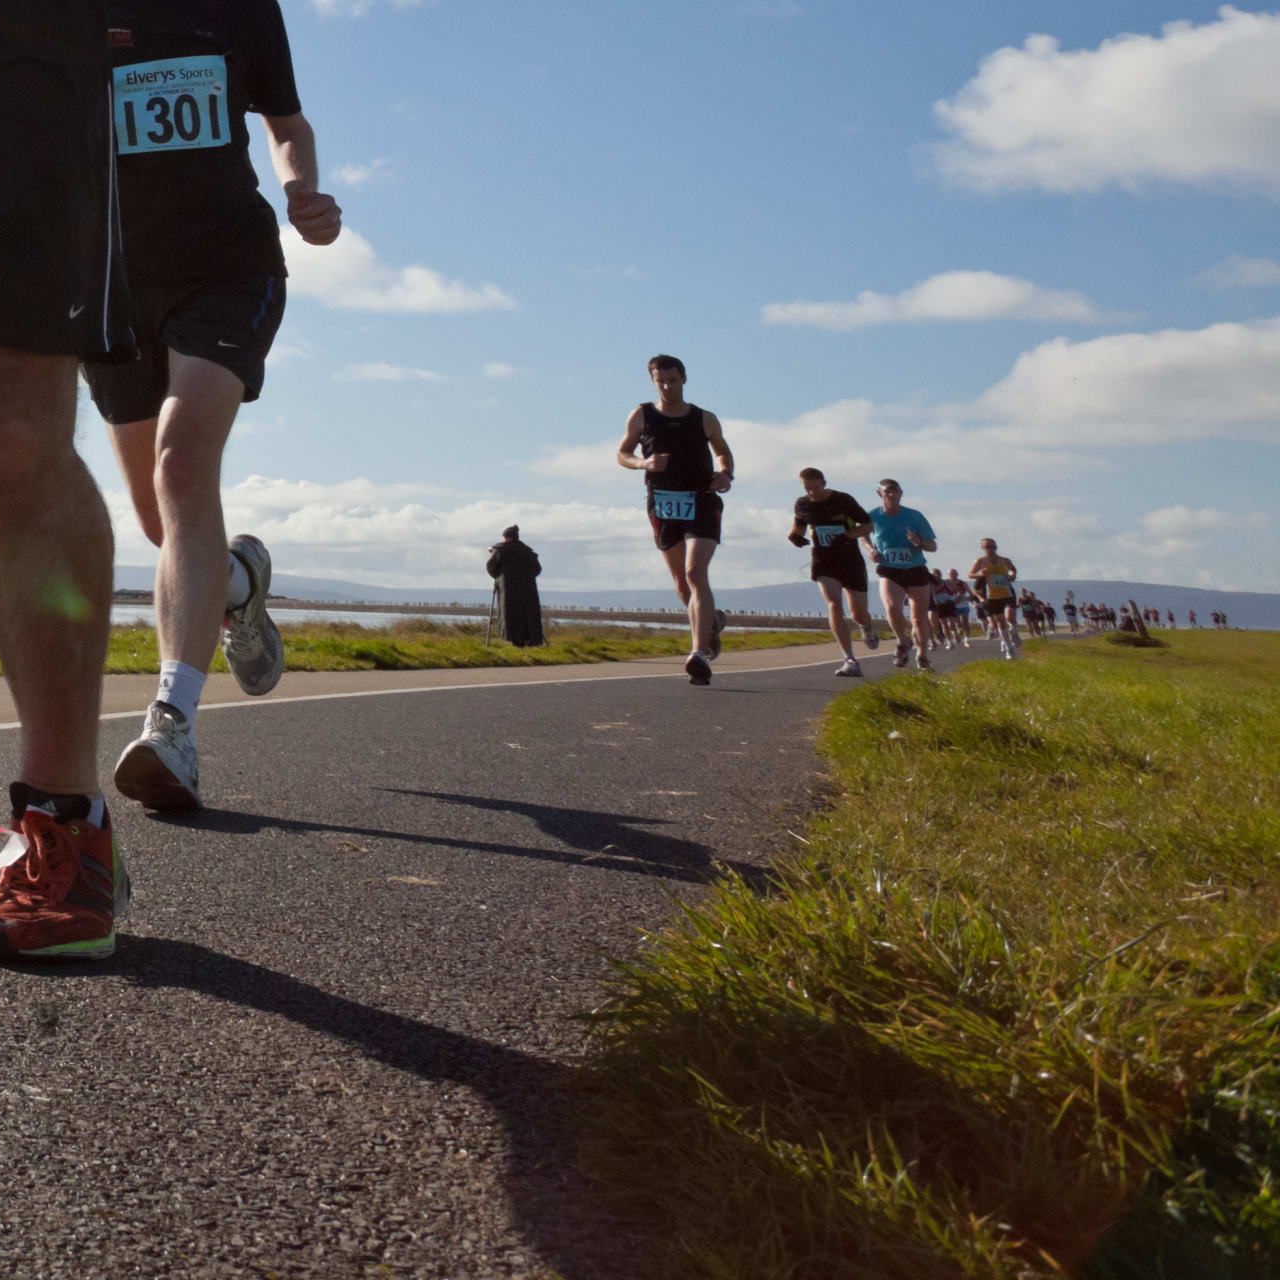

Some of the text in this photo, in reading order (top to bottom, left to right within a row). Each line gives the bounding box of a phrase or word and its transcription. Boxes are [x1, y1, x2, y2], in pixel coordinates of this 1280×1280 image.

[126, 68, 214, 85] Elverys Sports
[124, 93, 221, 146] 1301
[658, 500, 694, 518] 1317
